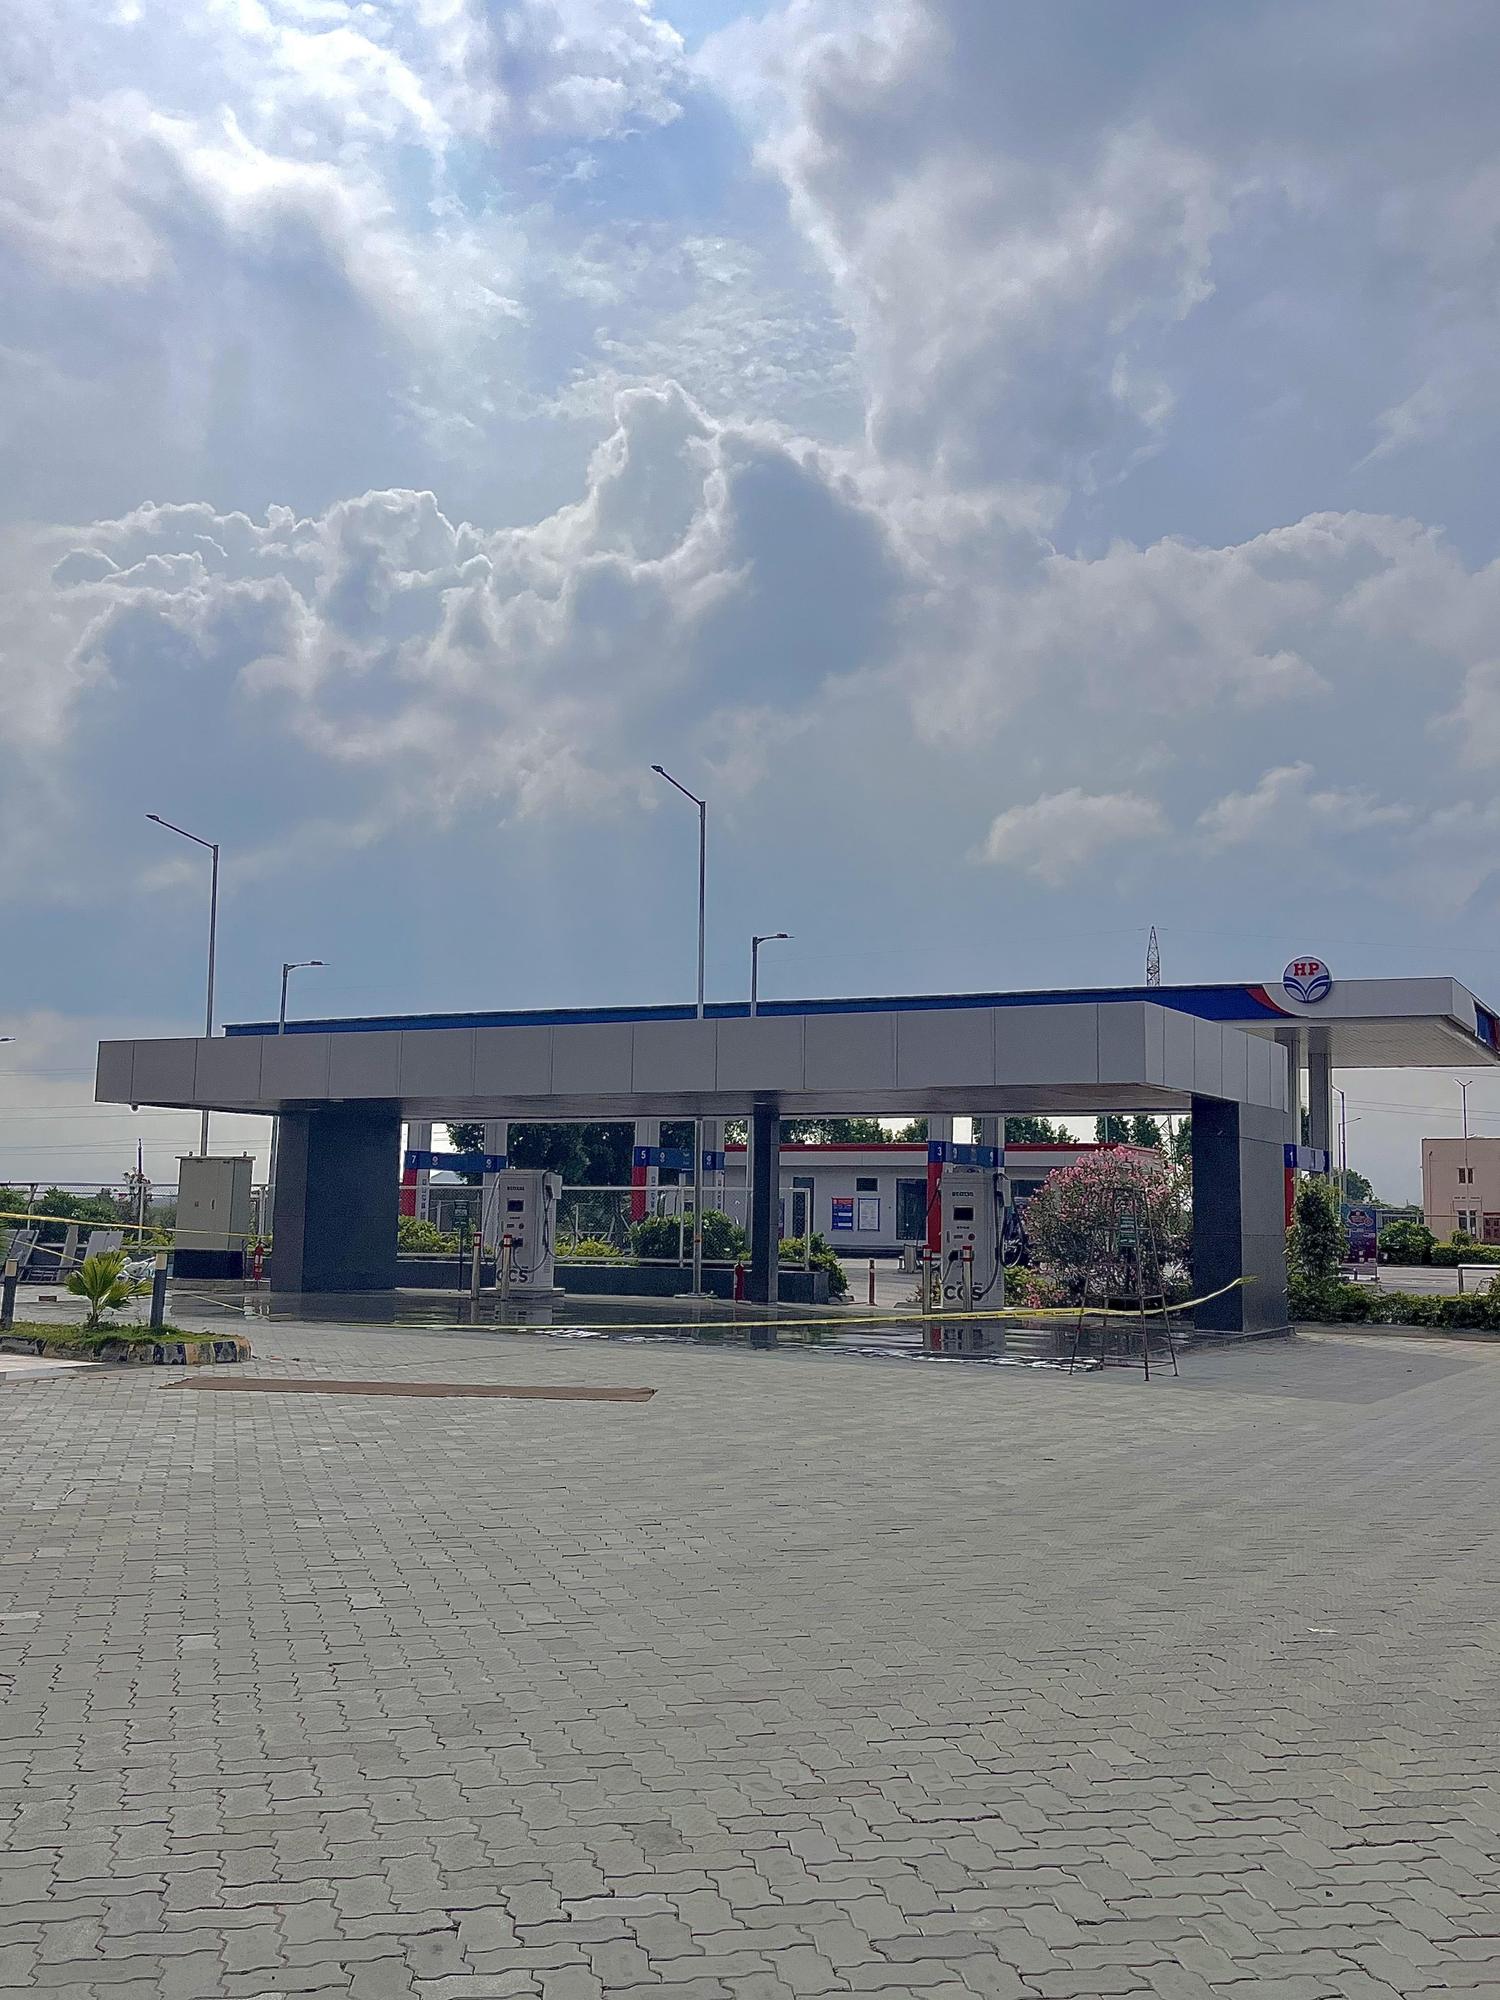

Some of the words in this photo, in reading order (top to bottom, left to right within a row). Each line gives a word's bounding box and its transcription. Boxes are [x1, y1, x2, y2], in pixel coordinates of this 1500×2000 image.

[1293, 962, 1320, 977] HP
[640, 1150, 647, 1160] 5
[936, 1146, 942, 1156] 3
[411, 1154, 417, 1164] 7
